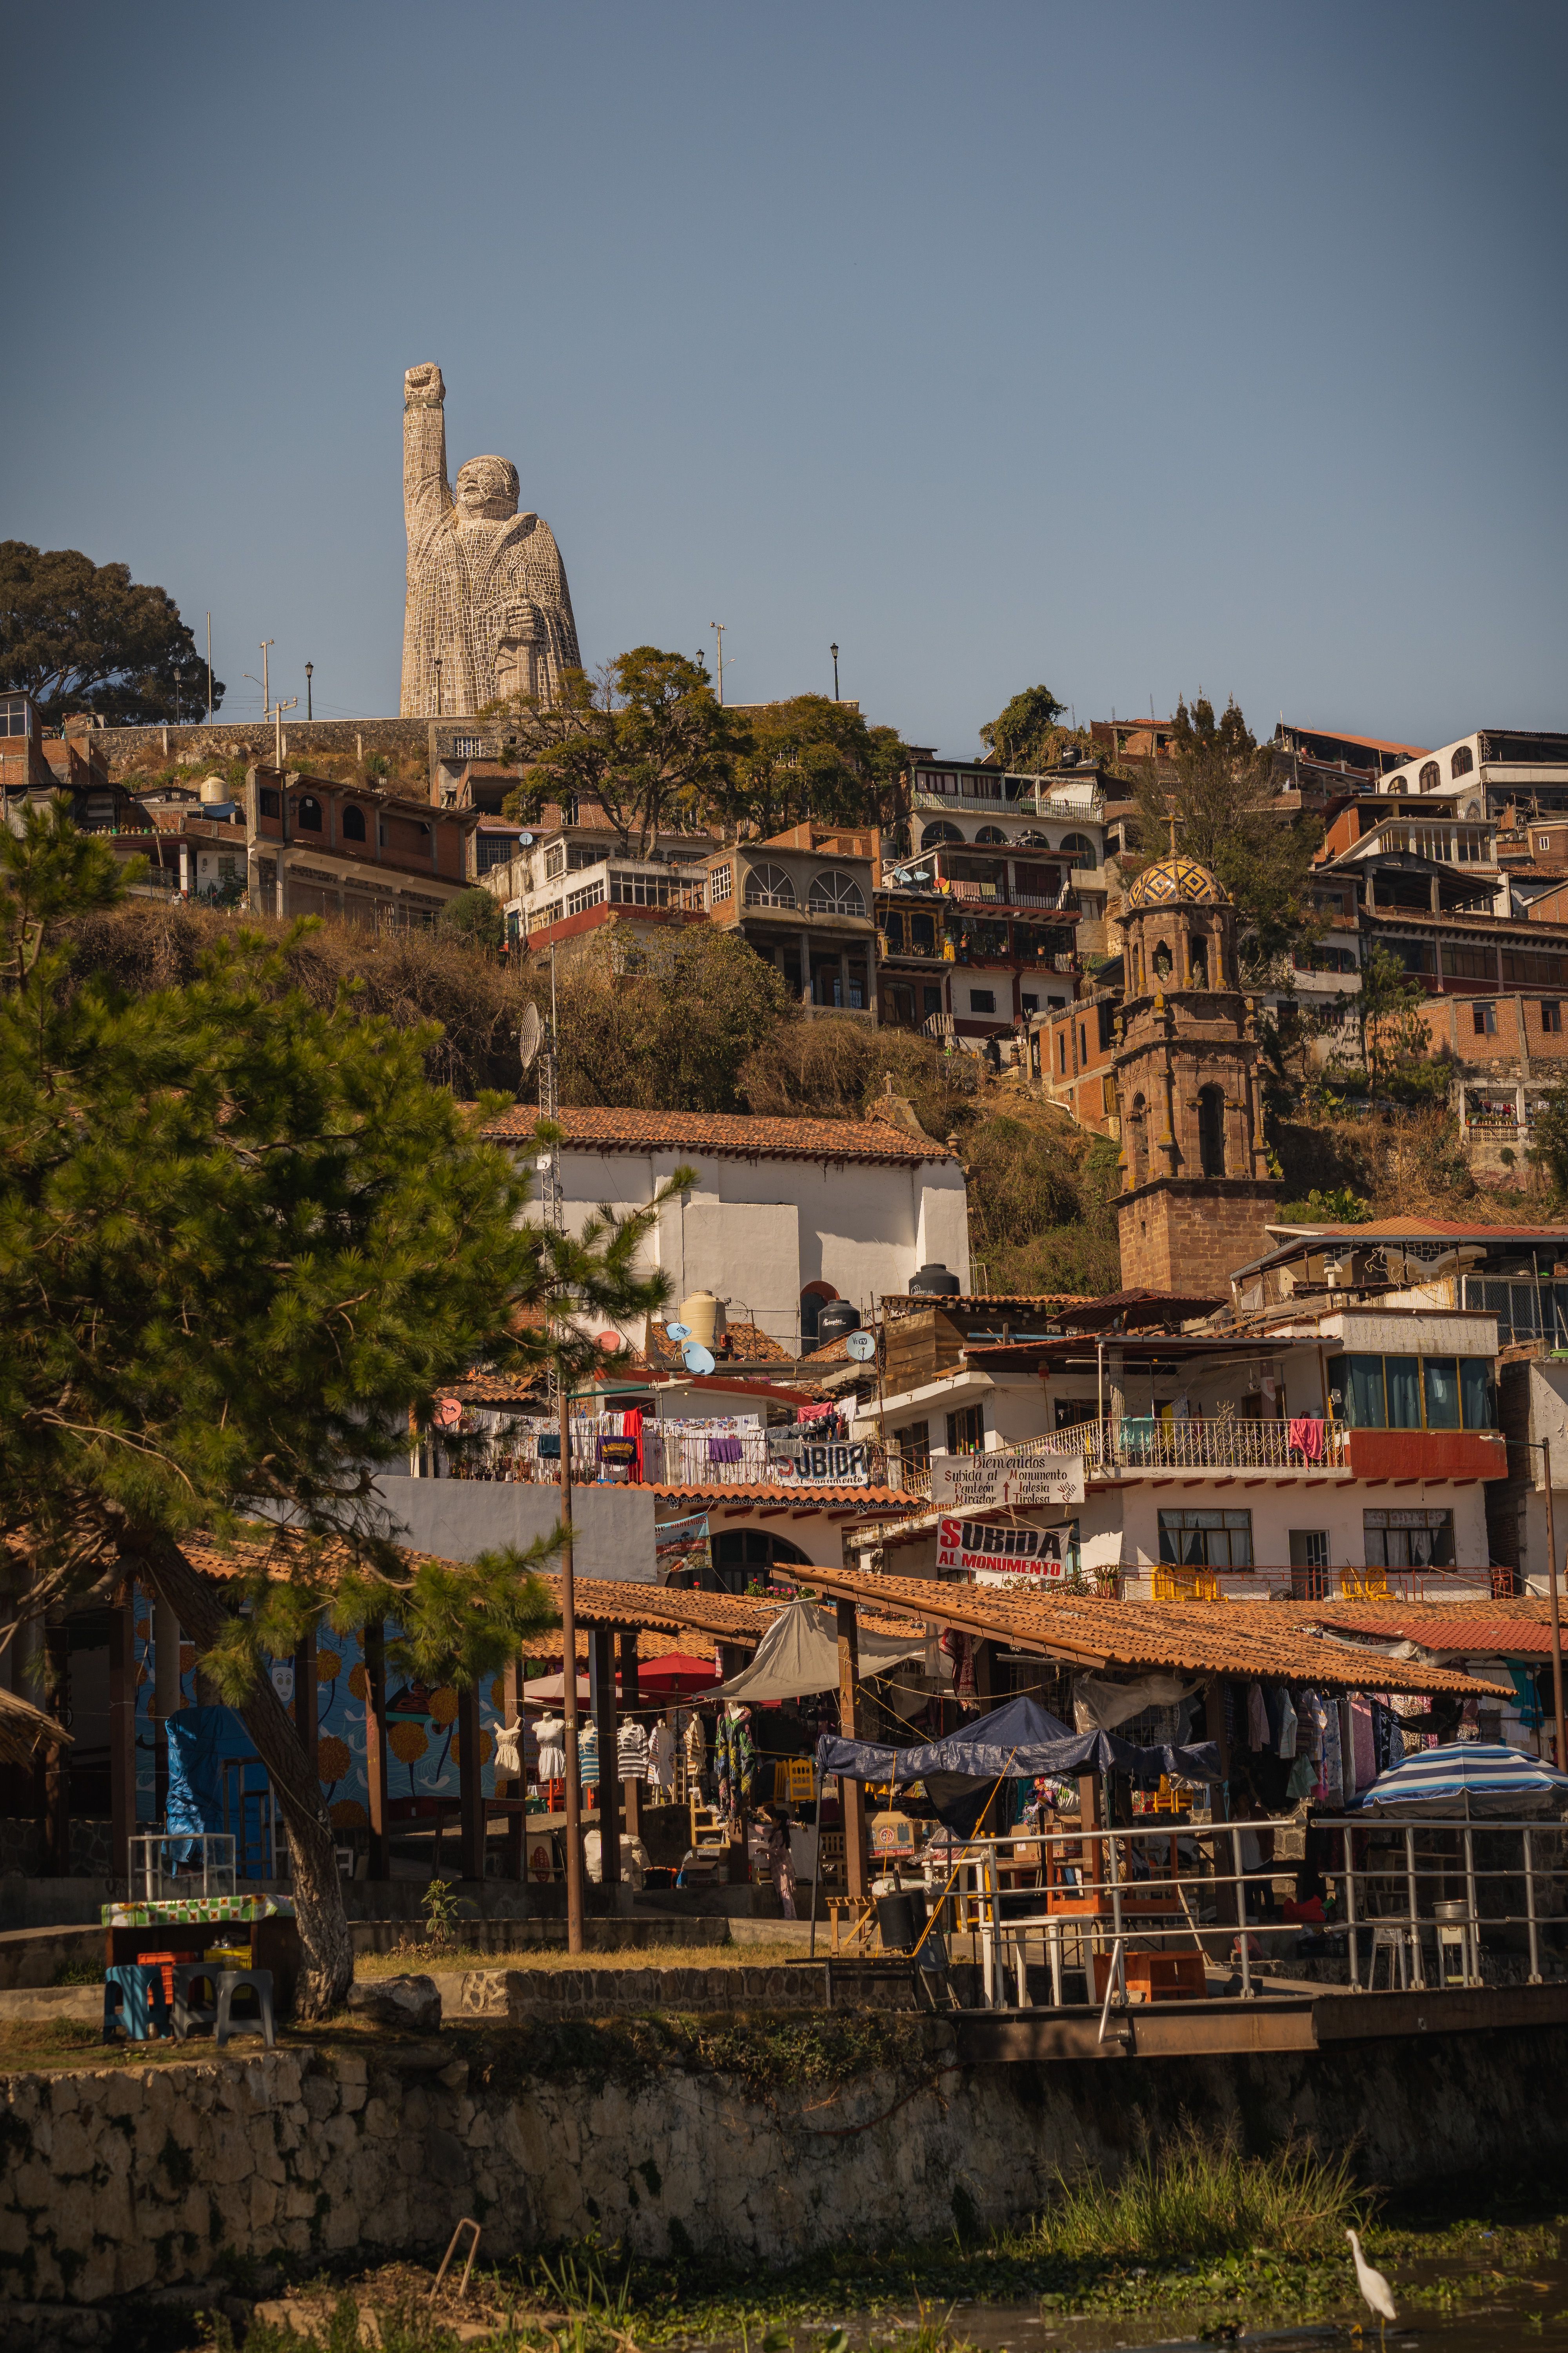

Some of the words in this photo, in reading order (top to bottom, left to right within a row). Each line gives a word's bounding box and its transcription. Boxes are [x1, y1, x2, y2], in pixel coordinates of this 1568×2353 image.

[778, 1445, 867, 1478] SUBIDA
[973, 1455, 1045, 1469] Bienvenidos
[806, 1475, 863, 1484] Monumento
[945, 1470, 982, 1482] Subida
[987, 1469, 997, 1480] al
[1007, 1469, 1067, 1480] Monumento
[955, 1482, 994, 1493] Panteón
[1019, 1481, 1050, 1495] Iglesia
[1062, 1484, 1077, 1502] Corta
[952, 1493, 996, 1504] Mirador
[1013, 1493, 1050, 1504] Tirolesa
[670, 1516, 707, 1529] BIENVENIDOS
[940, 1519, 1062, 1560] SUBIDA
[939, 1551, 957, 1566] AL
[961, 1553, 1061, 1577] MONUMENTO
